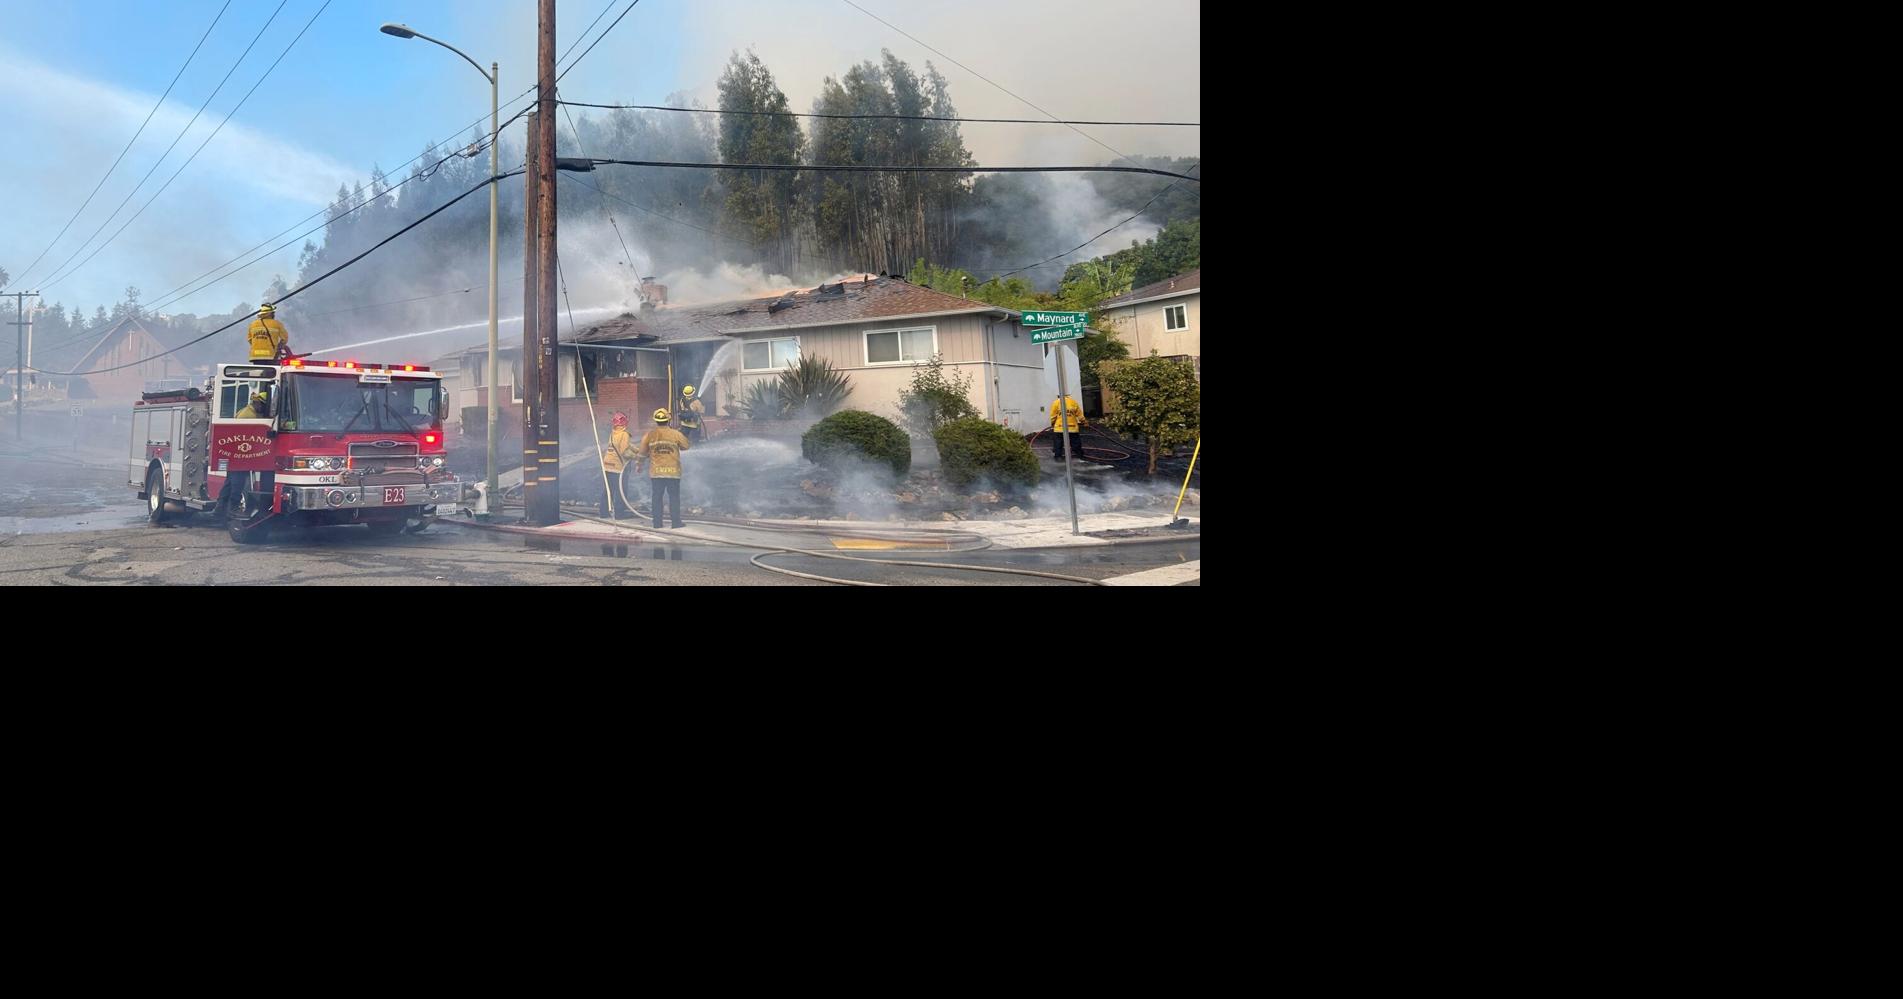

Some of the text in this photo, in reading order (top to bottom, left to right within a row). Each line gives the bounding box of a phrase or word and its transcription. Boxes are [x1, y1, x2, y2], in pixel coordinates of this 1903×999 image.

[1037, 313, 1075, 325] Maynard
[1041, 328, 1073, 340] Mountain
[218, 435, 272, 446] OAKLAND
[218, 449, 271, 459] FIRE DEPARTMENT
[318, 475, 337, 483] OKL
[384, 488, 405, 503] E23
